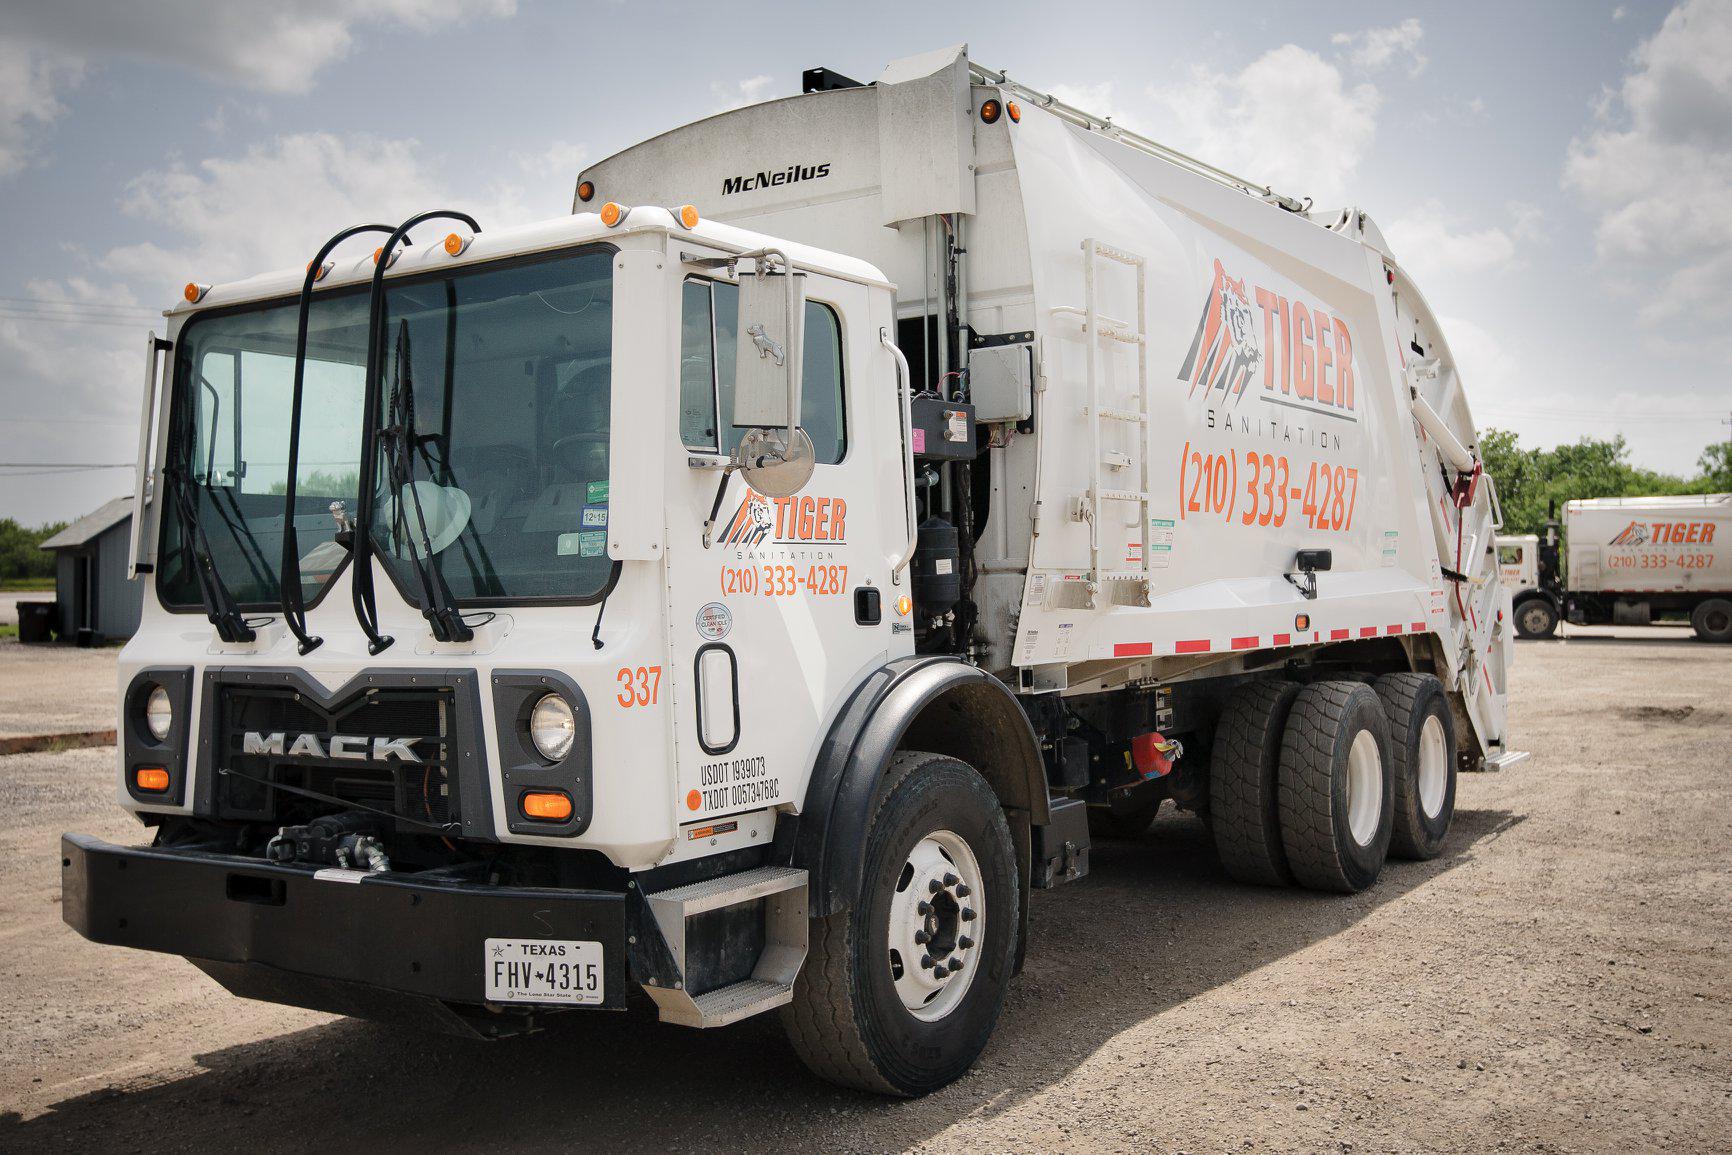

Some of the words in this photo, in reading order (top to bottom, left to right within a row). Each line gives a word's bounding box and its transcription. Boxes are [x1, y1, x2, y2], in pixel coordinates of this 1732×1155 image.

[722, 163, 830, 195] McNeilus
[1255, 285, 1355, 411] TIGER
[1207, 409, 1341, 450] SANITATION
[1179, 441, 1237, 522] (210)
[1242, 451, 1358, 532] 333-4287
[773, 495, 847, 540] TIGER
[1651, 522, 1715, 544] TIGER
[737, 551, 833, 560] SANITATION
[1608, 554, 1637, 569] (210)
[1640, 553, 1714, 569] 333-4287
[720, 565, 759, 597] (210)
[763, 565, 848, 596] 333-4287
[617, 665, 662, 708] 337
[243, 731, 423, 763] MACK
[701, 762, 729, 786] USDOT
[732, 756, 766, 781] 1939073
[702, 787, 728, 811] TXDOT
[732, 778, 780, 806] 005734768C
[521, 944, 566, 956] TEXAS
[494, 961, 532, 989] FHV
[546, 962, 597, 991] 4315
